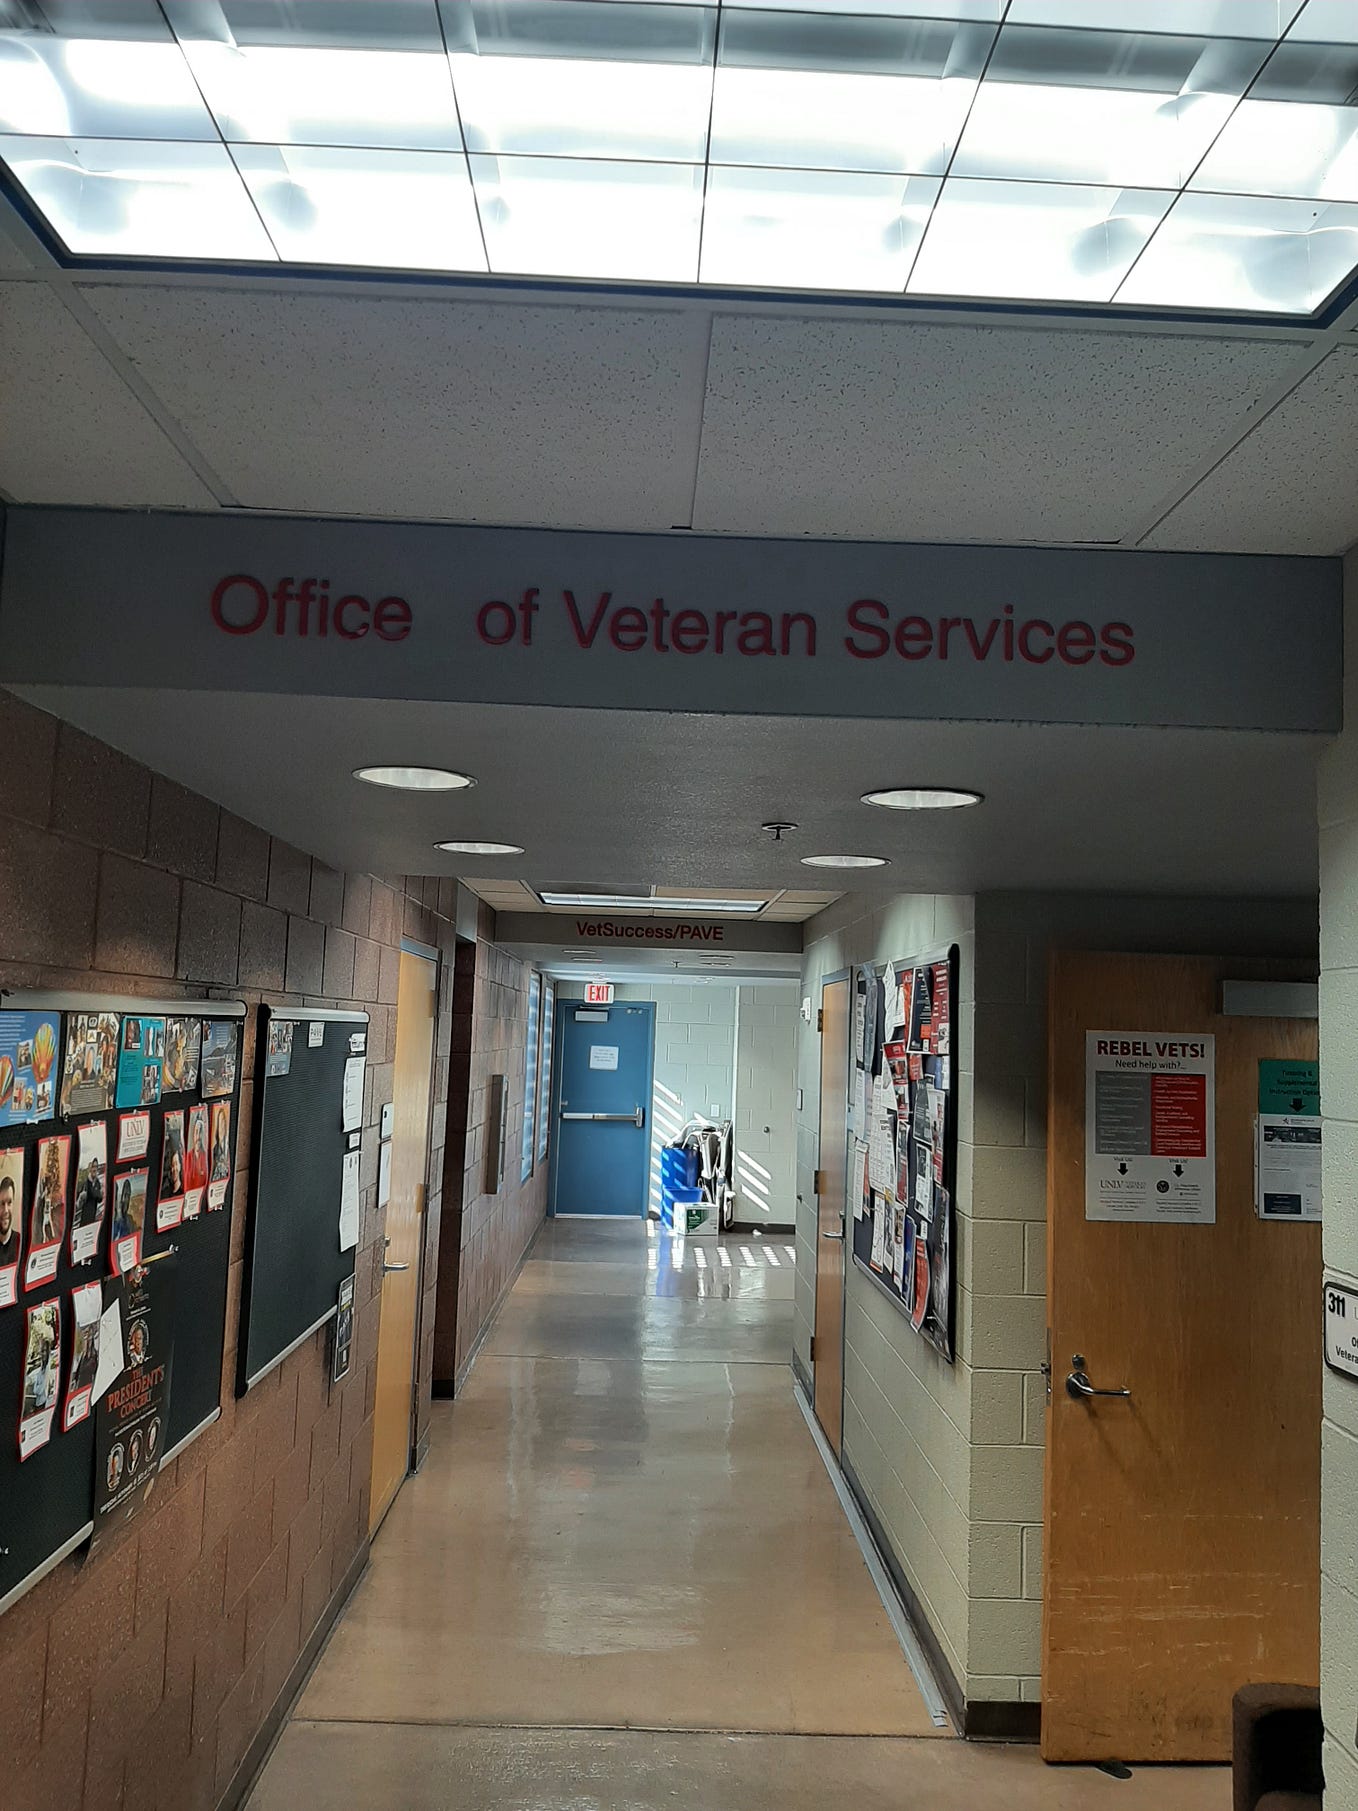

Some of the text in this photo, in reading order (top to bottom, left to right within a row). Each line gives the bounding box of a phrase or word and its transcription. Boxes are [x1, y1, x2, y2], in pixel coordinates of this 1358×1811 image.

[210, 573, 1136, 667] Office of Veteran Services
[577, 920, 724, 941] VetSuccess/PAVE
[586, 985, 611, 1002] EXIT
[1096, 1040, 1205, 1059] REBEL VETS!
[1115, 1059, 1138, 1069] Need
[1138, 1060, 1158, 1071] help
[1328, 1292, 1345, 1318] 311
